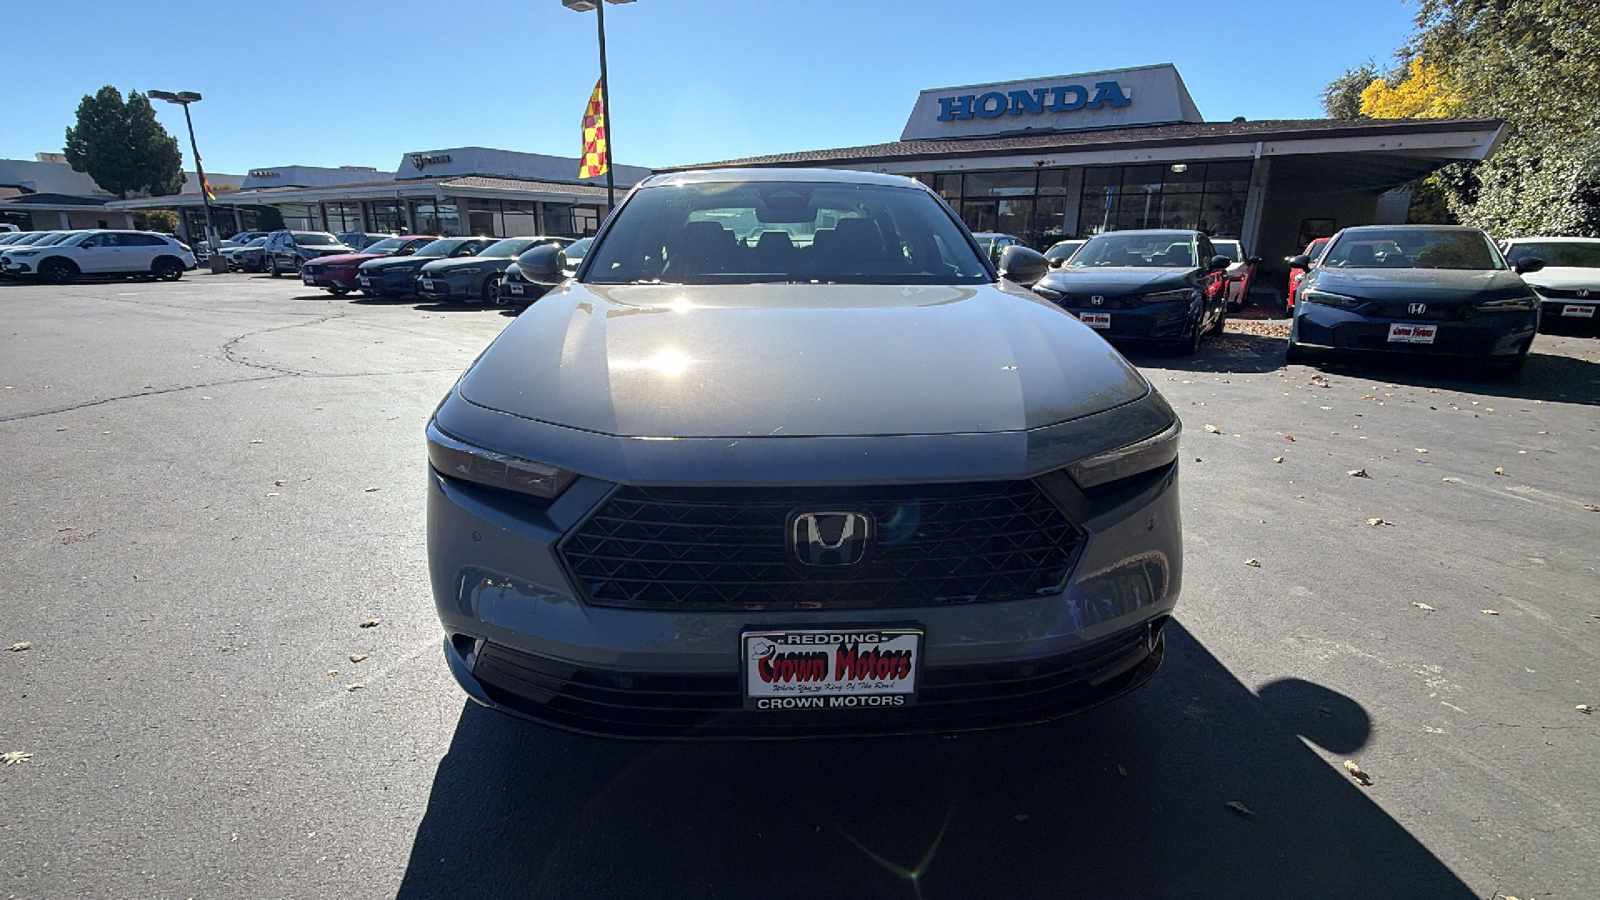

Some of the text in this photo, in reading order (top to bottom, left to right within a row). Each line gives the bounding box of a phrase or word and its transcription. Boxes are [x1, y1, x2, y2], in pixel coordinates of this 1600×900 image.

[937, 81, 1131, 121] HONDA
[787, 634, 879, 645] REDDING
[758, 643, 912, 684] Crown Motors
[773, 684, 795, 692] Where
[824, 682, 843, 692] King
[846, 682, 856, 692] Of
[859, 681, 873, 690] The
[874, 681, 896, 689] Road
[757, 695, 904, 709] CROWN MOTORS
